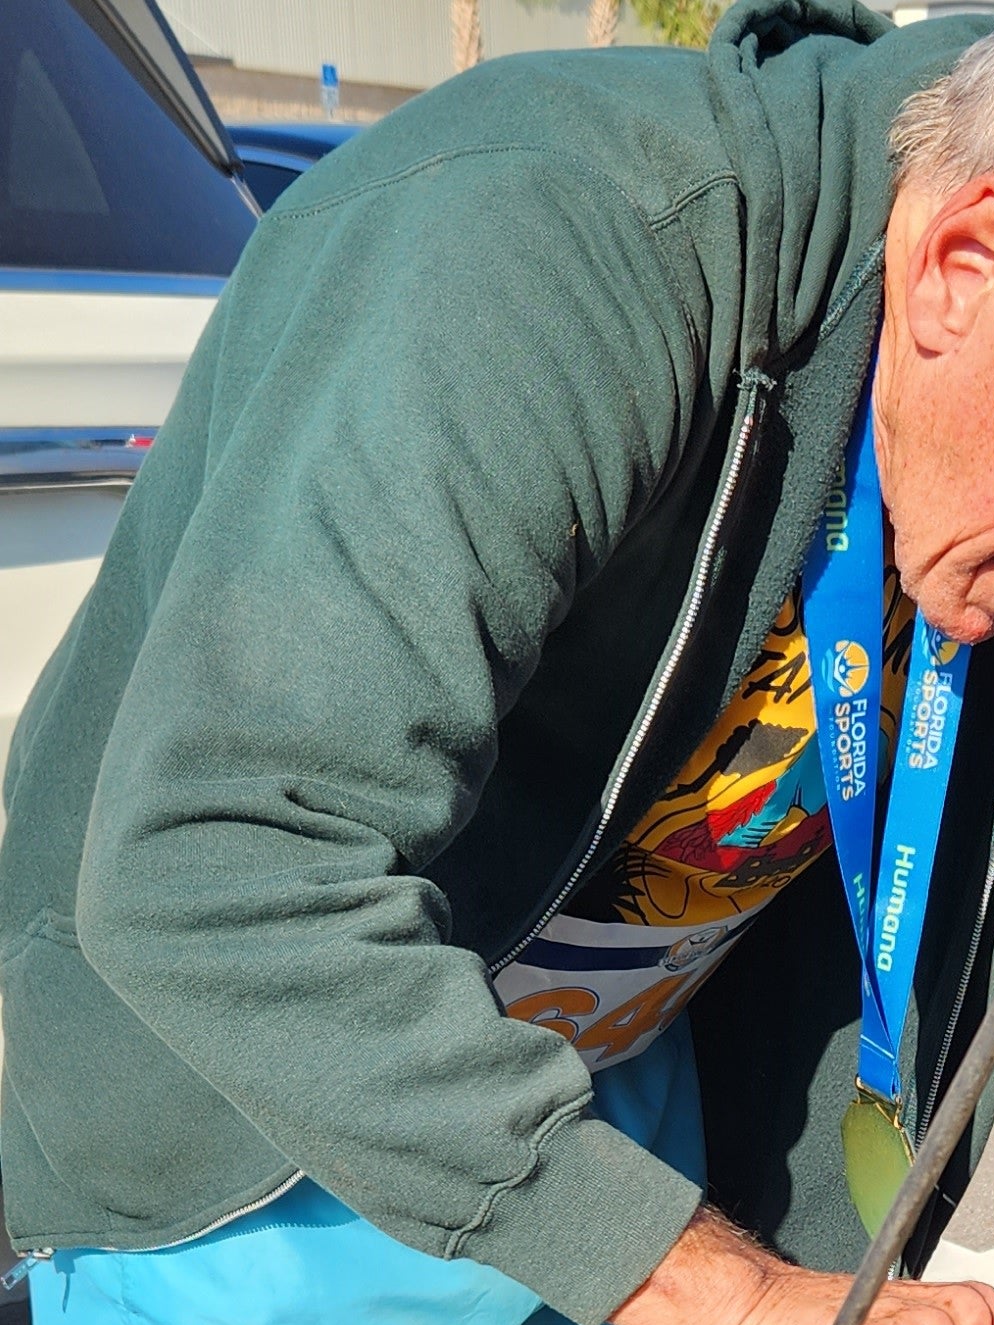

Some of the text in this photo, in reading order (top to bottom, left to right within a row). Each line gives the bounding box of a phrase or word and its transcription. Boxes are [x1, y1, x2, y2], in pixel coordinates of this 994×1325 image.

[835, 702, 854, 801] SPORTS
[851, 698, 868, 797] FLORIDA
[909, 669, 938, 769] SPORTS
[923, 672, 953, 769] FLORIDA
[878, 844, 917, 973] Humana
